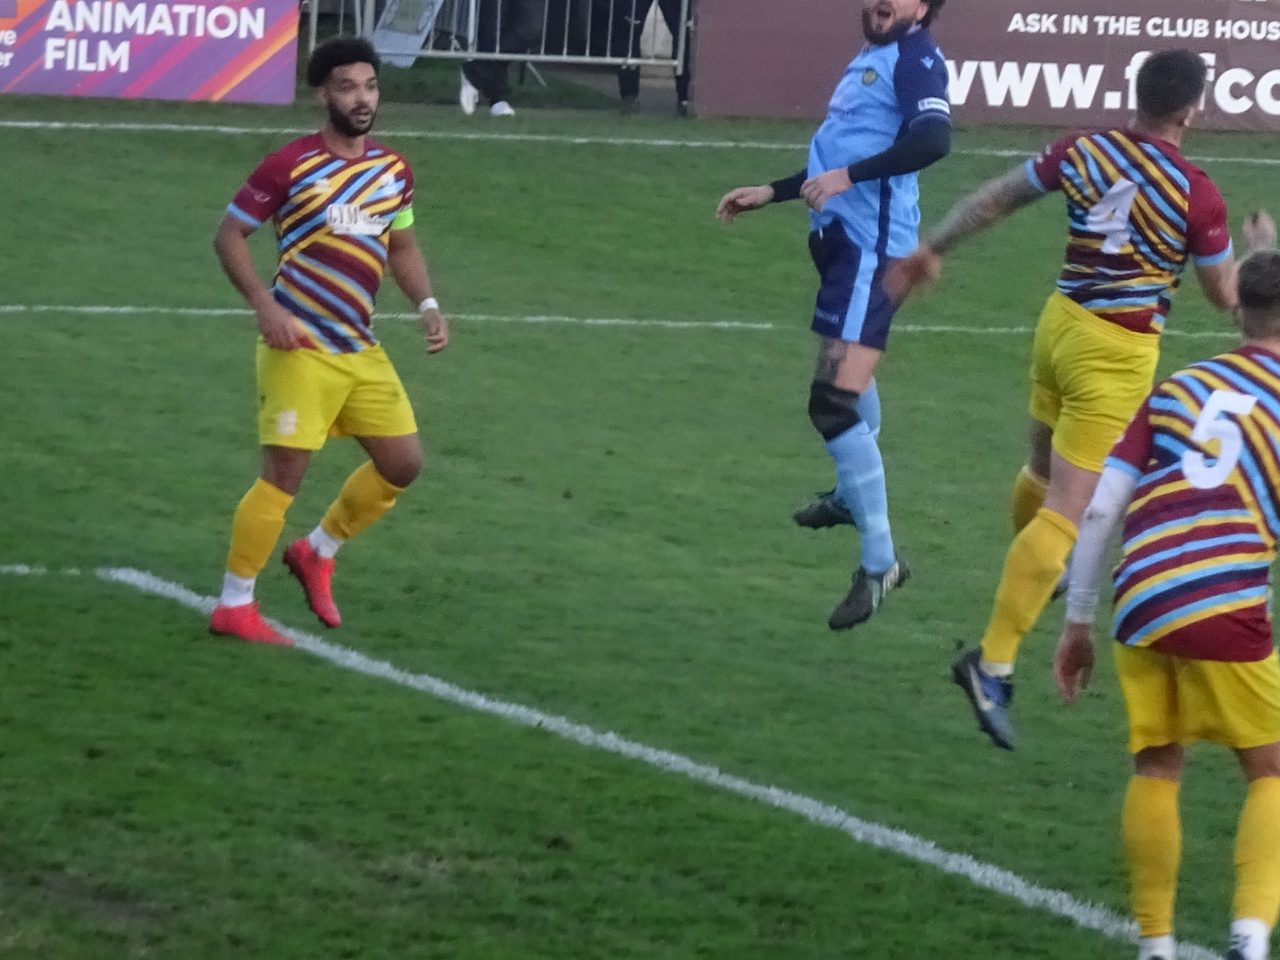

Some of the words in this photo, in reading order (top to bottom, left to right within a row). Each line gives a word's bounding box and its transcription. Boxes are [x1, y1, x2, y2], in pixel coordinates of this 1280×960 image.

[45, 0, 265, 39] ANIMATION
[1008, 13, 1058, 33] ASK
[1062, 14, 1088, 34] IN
[1094, 15, 1141, 36] THE
[1146, 17, 1210, 38] CLUB
[44, 37, 131, 73] FILM
[1182, 390, 1258, 489] 5
